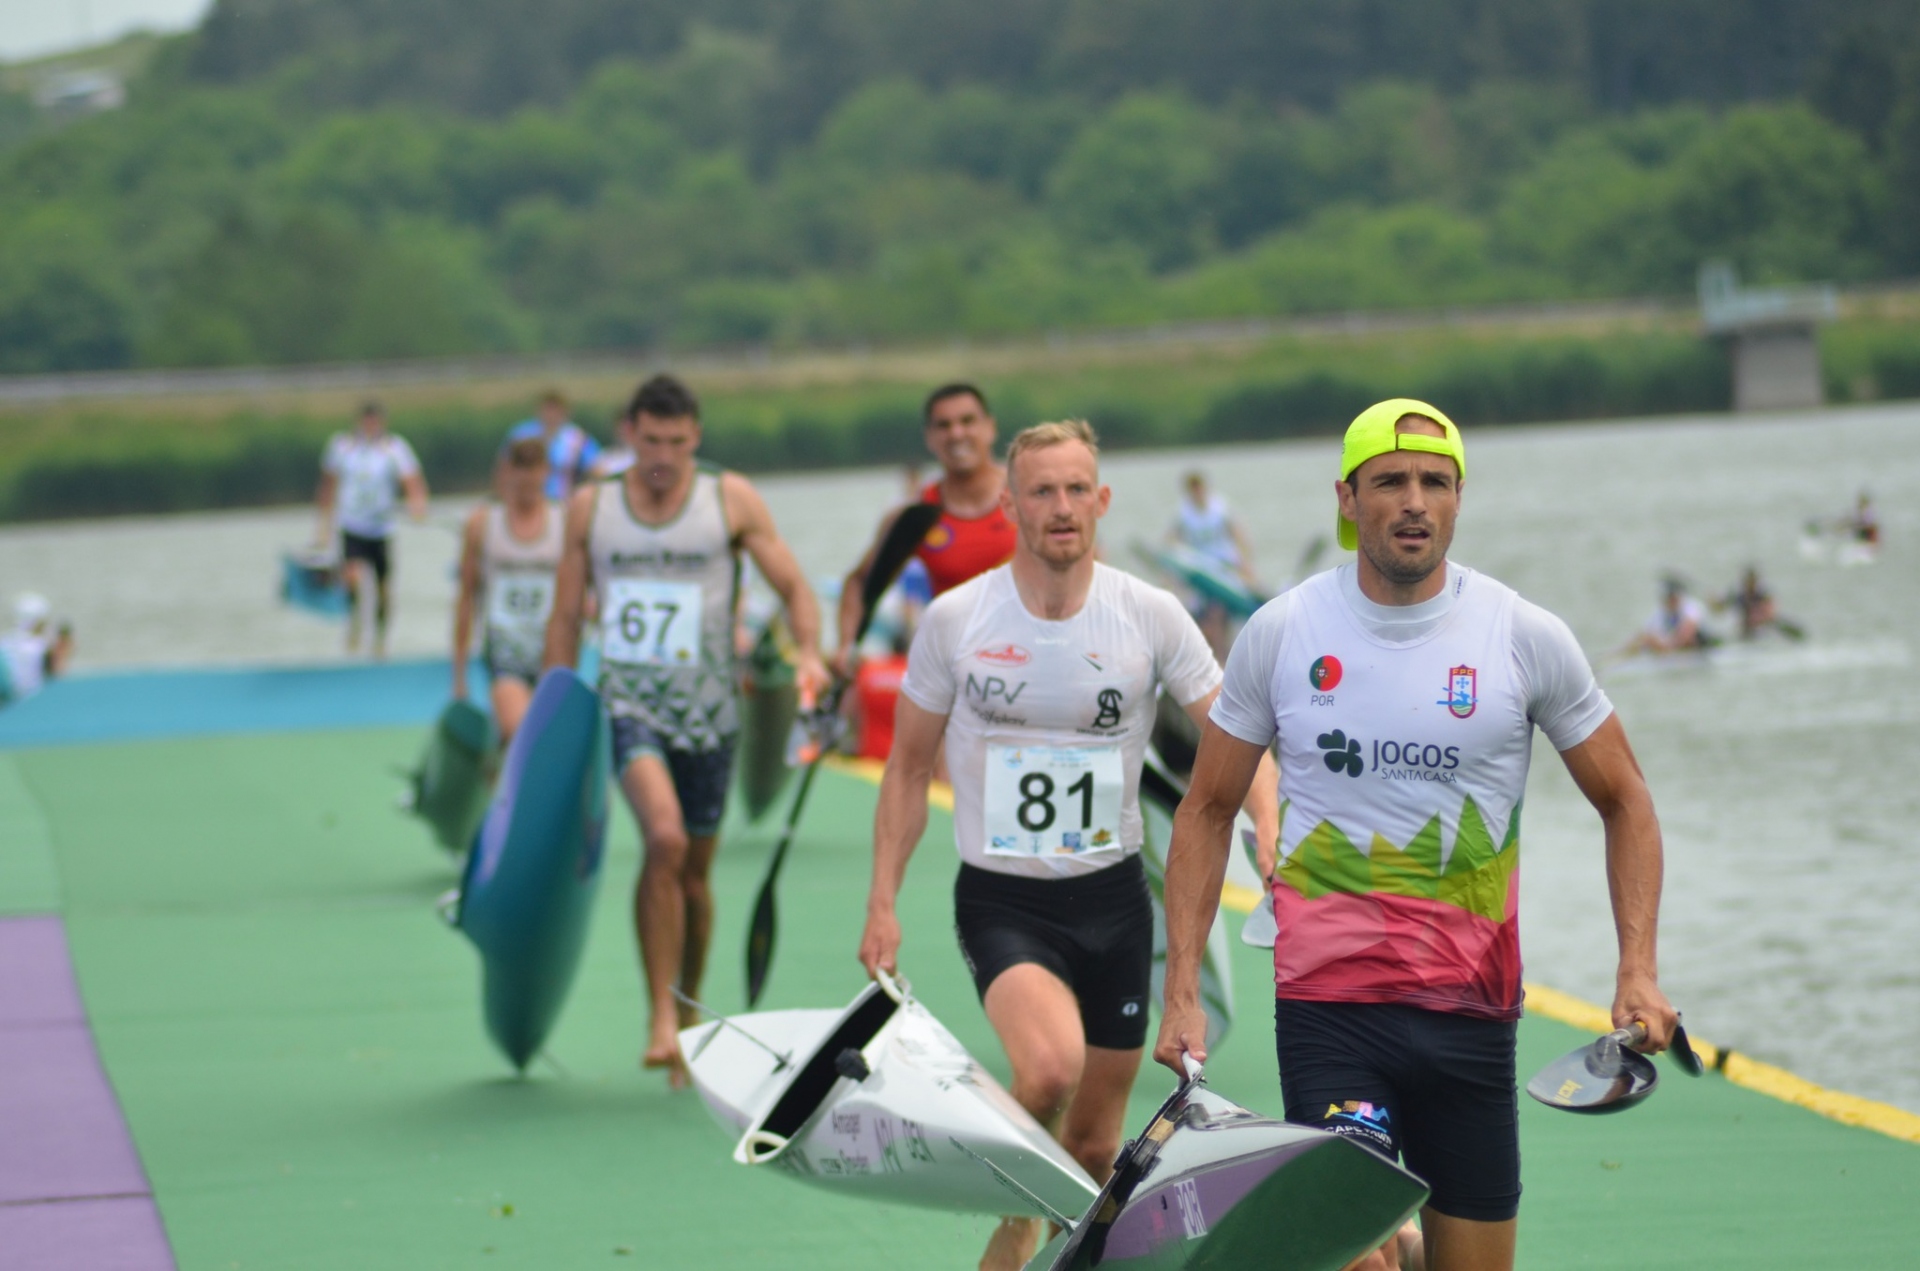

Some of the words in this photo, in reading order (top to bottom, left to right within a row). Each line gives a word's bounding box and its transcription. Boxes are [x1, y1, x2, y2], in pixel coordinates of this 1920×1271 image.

[619, 600, 681, 645] 67
[1310, 694, 1335, 707] POR
[1371, 739, 1461, 772] JOGOS
[1381, 767, 1457, 784] SANTACASA
[1016, 771, 1094, 833] 81
